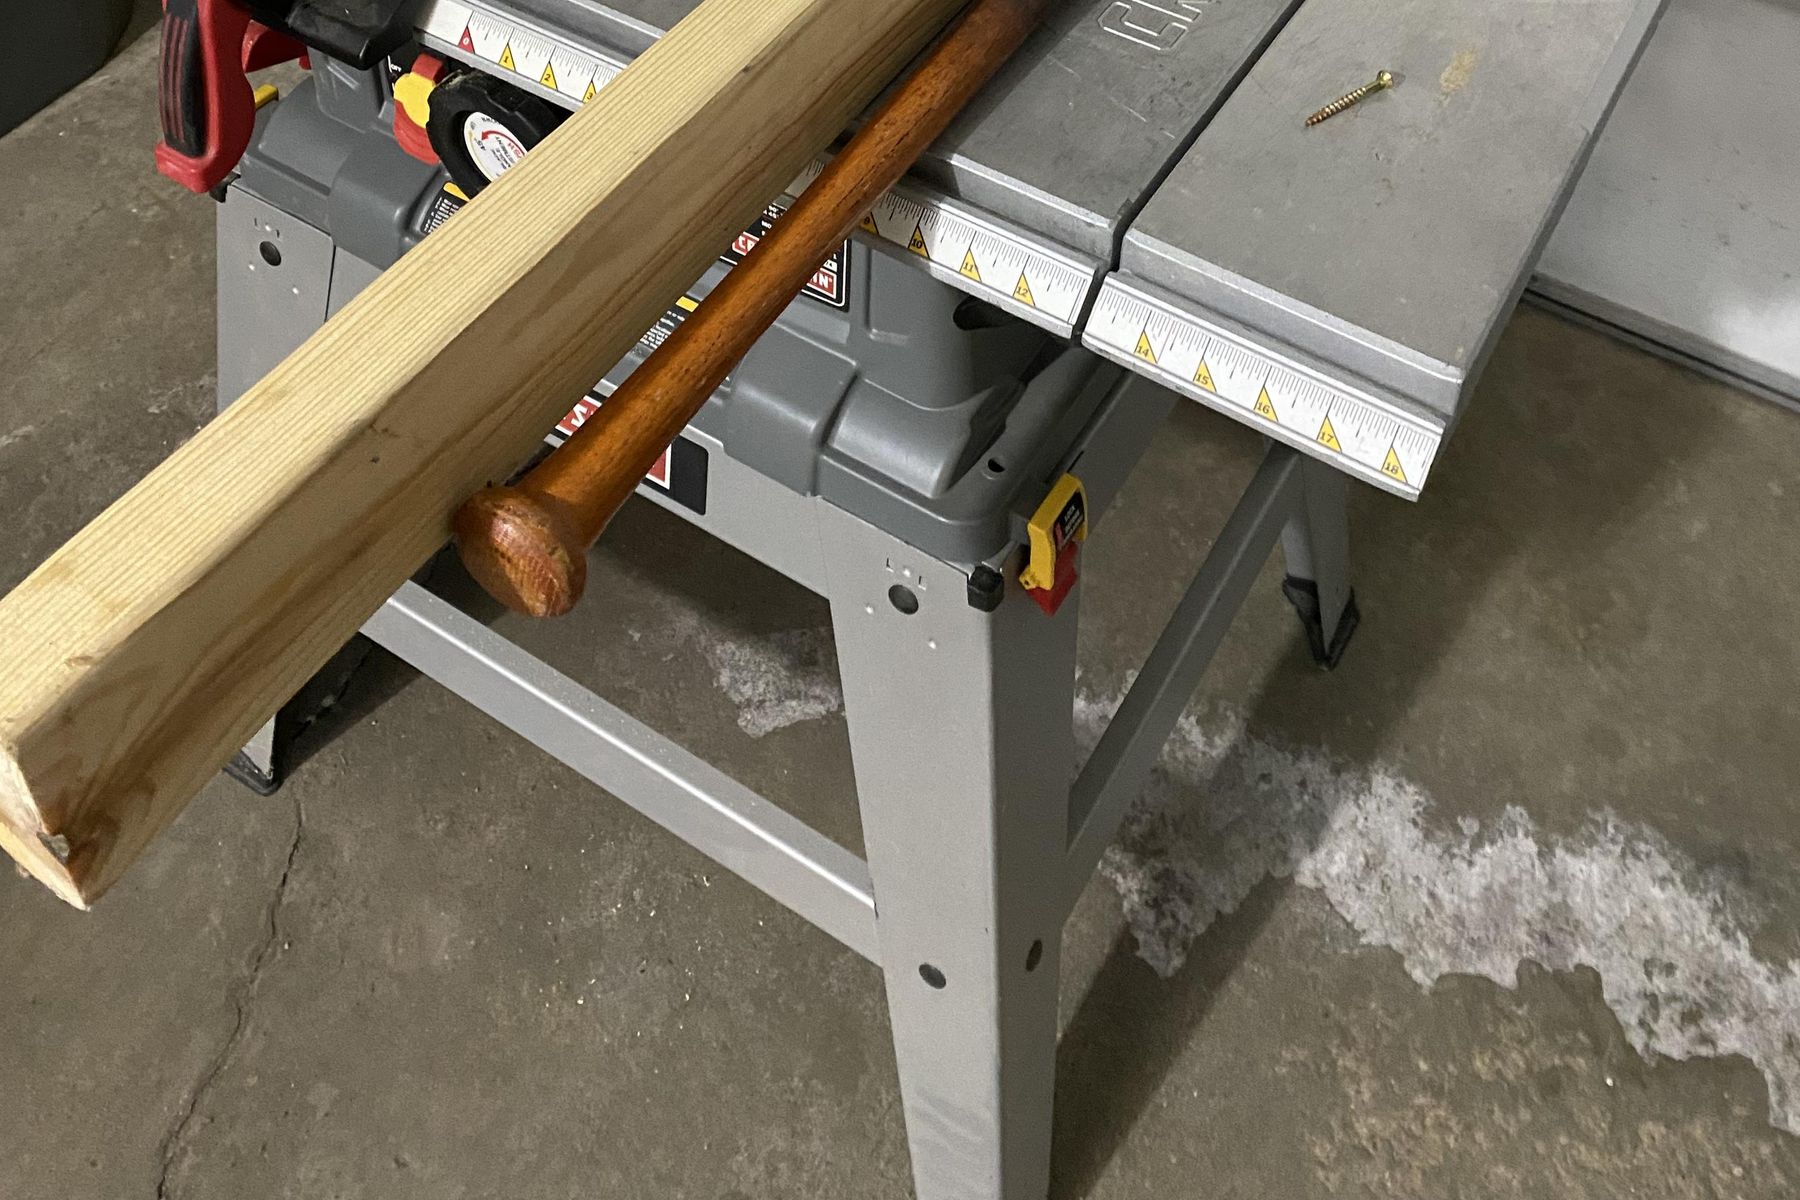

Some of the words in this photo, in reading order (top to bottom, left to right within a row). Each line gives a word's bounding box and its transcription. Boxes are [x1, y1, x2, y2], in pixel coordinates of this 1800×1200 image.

[462, 37, 470, 46] 0
[543, 73, 551, 82] 2
[586, 92, 594, 101] 3
[911, 237, 924, 250] 10
[962, 261, 975, 274] 11
[1016, 285, 1029, 297] 12
[1136, 345, 1150, 358] 14
[1195, 373, 1209, 386] 15
[1256, 402, 1270, 415] 16
[1319, 431, 1334, 444] 17
[1384, 462, 1399, 475] 18
